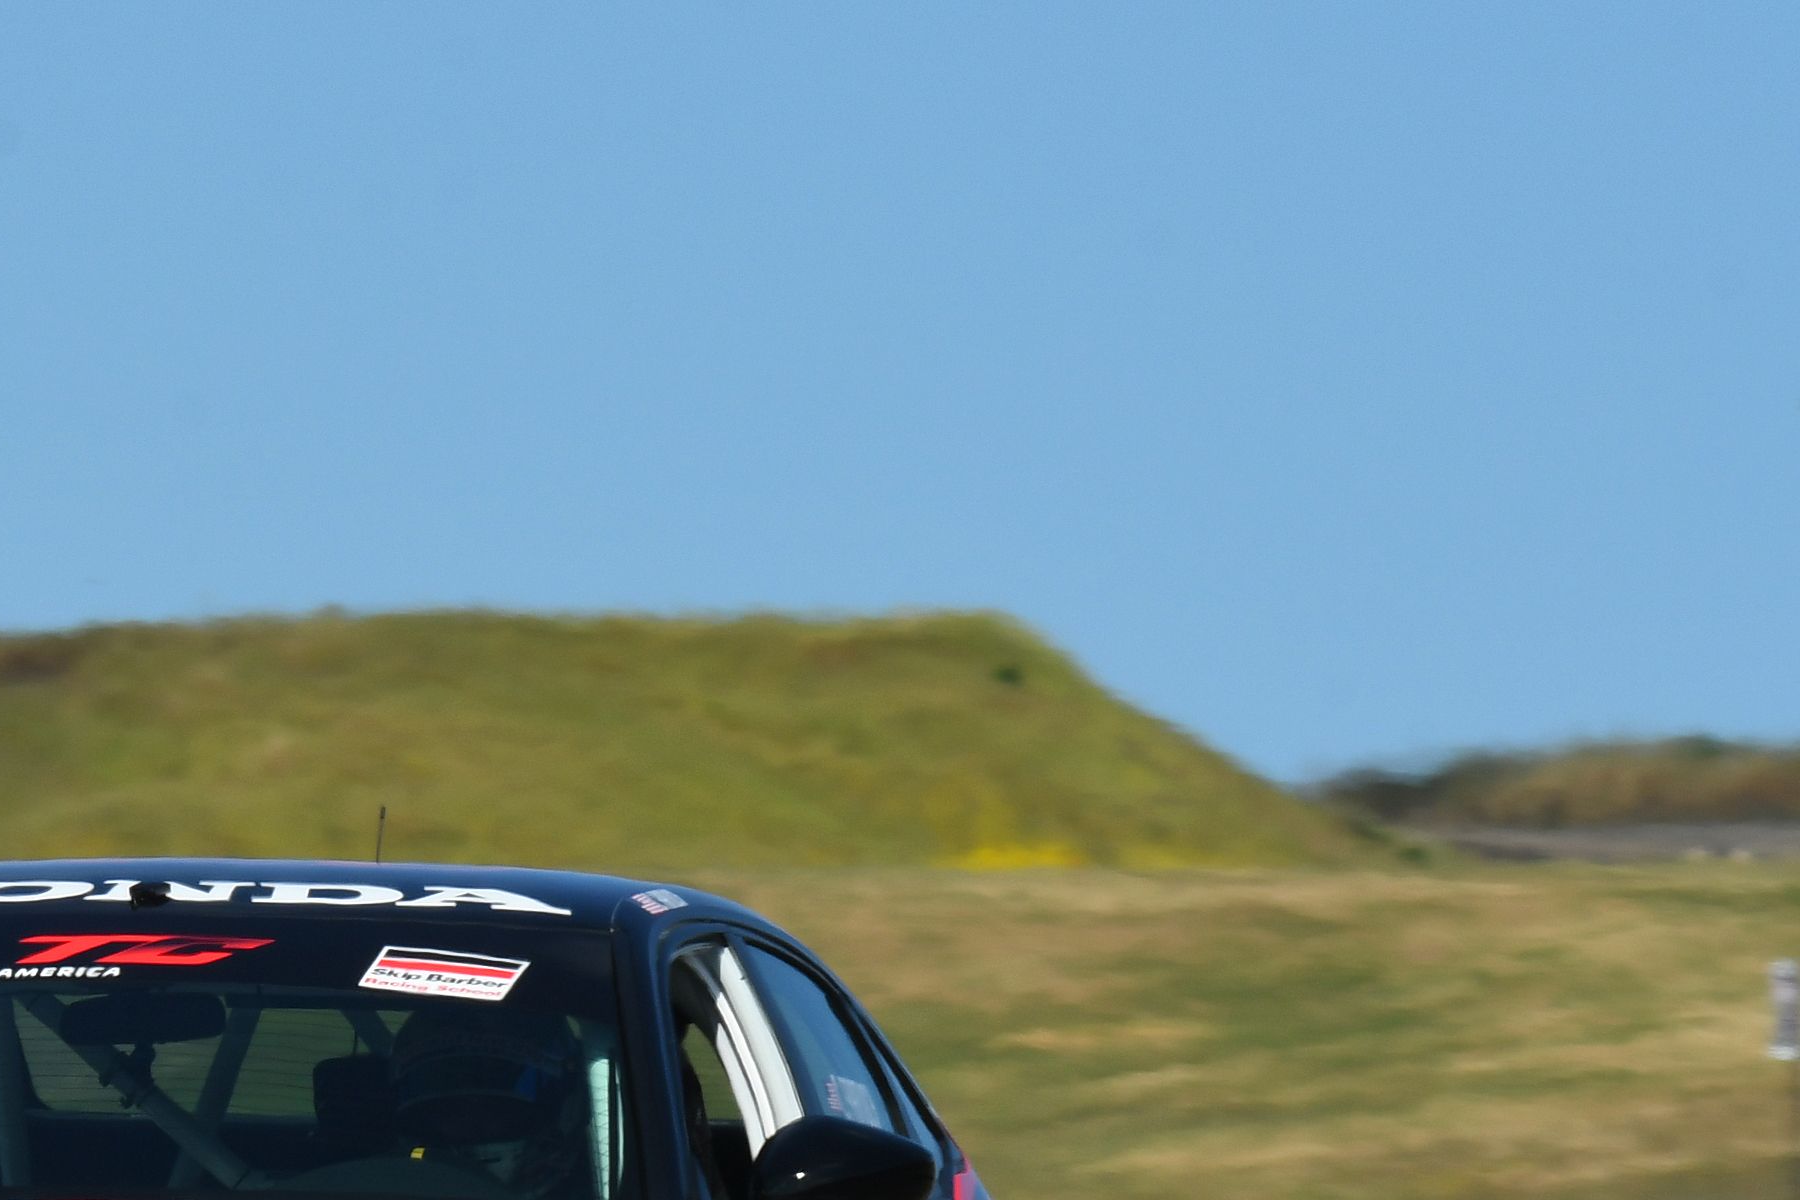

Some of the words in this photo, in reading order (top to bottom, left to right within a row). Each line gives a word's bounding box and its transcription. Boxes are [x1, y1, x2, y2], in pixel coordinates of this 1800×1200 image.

[364, 977, 429, 991] Racing
[437, 984, 502, 996] School
[371, 968, 421, 981] Skip
[426, 973, 507, 988] Barber
